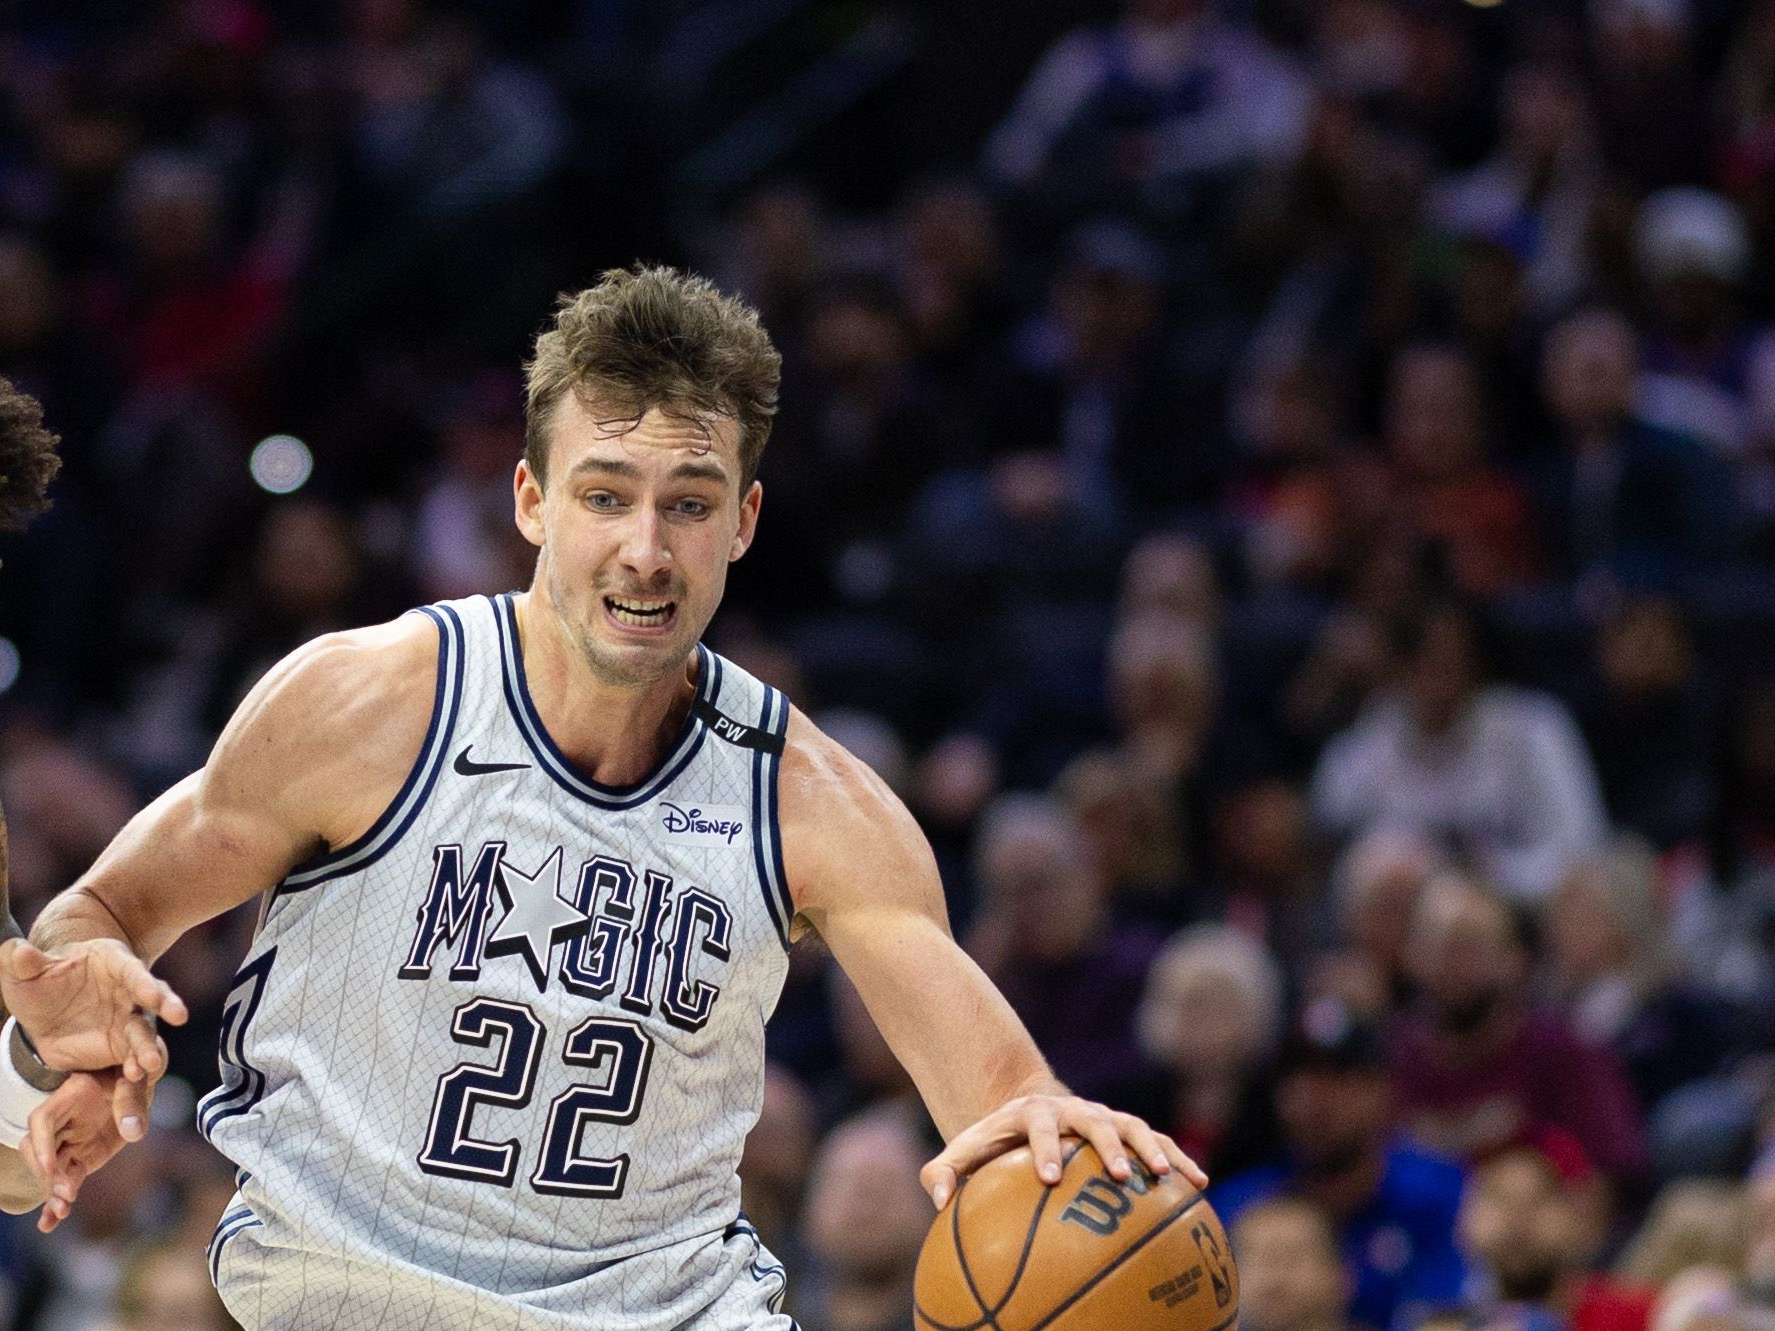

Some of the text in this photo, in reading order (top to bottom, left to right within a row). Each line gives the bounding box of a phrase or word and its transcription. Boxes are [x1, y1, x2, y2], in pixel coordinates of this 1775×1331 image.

[714, 717, 747, 742] PW
[659, 802, 743, 845] Disney
[419, 997, 654, 1199] 22
